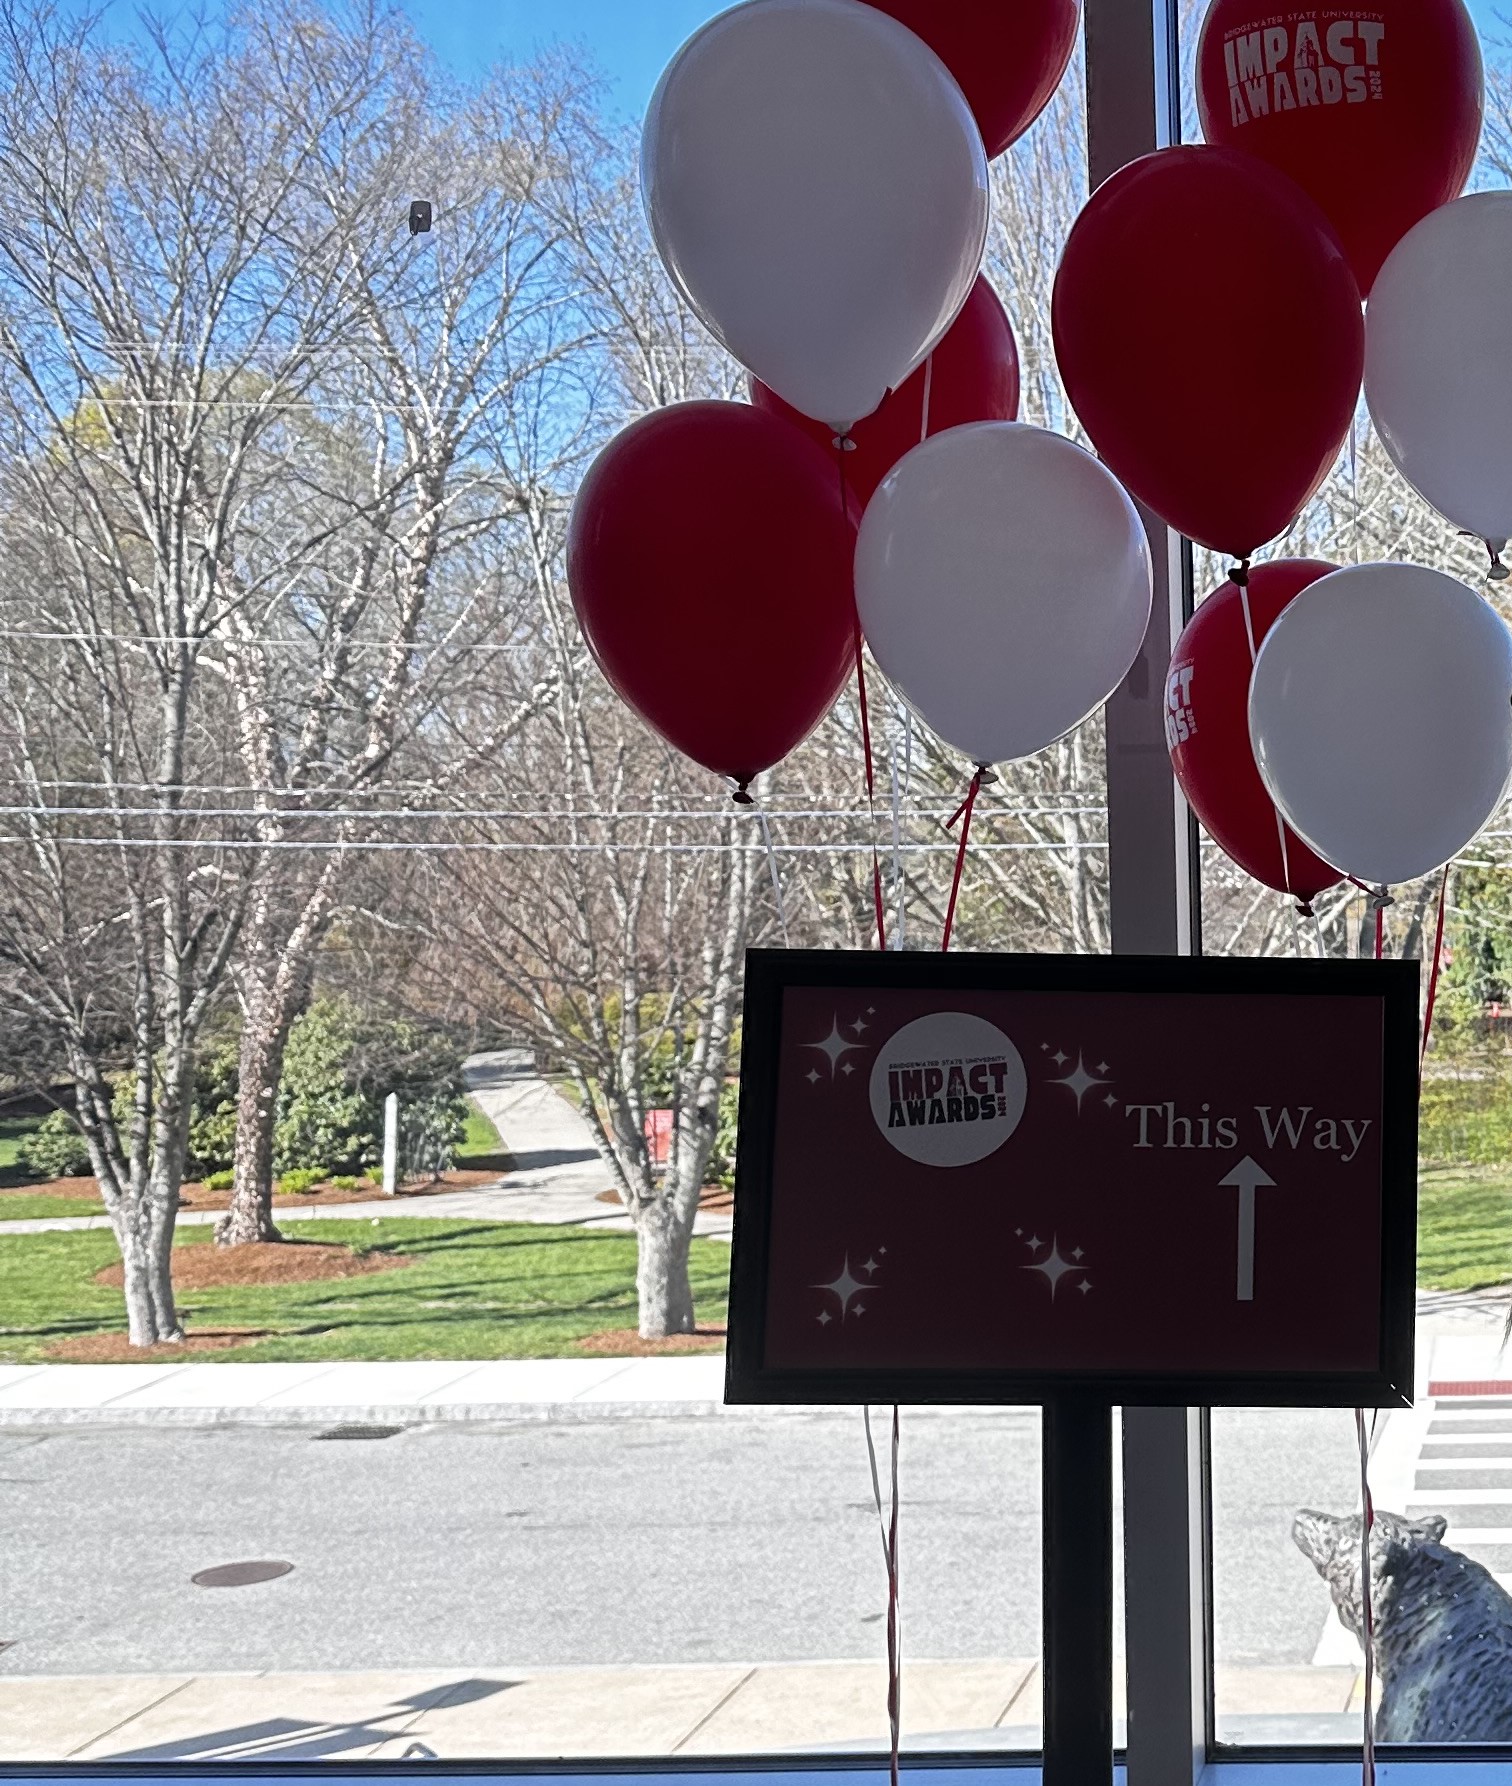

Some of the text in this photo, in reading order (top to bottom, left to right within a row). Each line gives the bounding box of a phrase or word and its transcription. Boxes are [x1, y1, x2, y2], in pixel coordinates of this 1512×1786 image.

[1287, 11, 1317, 22] STATE
[1322, 10, 1385, 21] UNIVERSITY
[1223, 20, 1385, 87] IMPACT
[1229, 65, 1368, 128] AWARDS
[1369, 70, 1384, 100] 2024
[888, 1063, 1008, 1102] IMPACT
[888, 1094, 997, 1128] AWARDS
[1125, 1101, 1373, 1162] This Way
